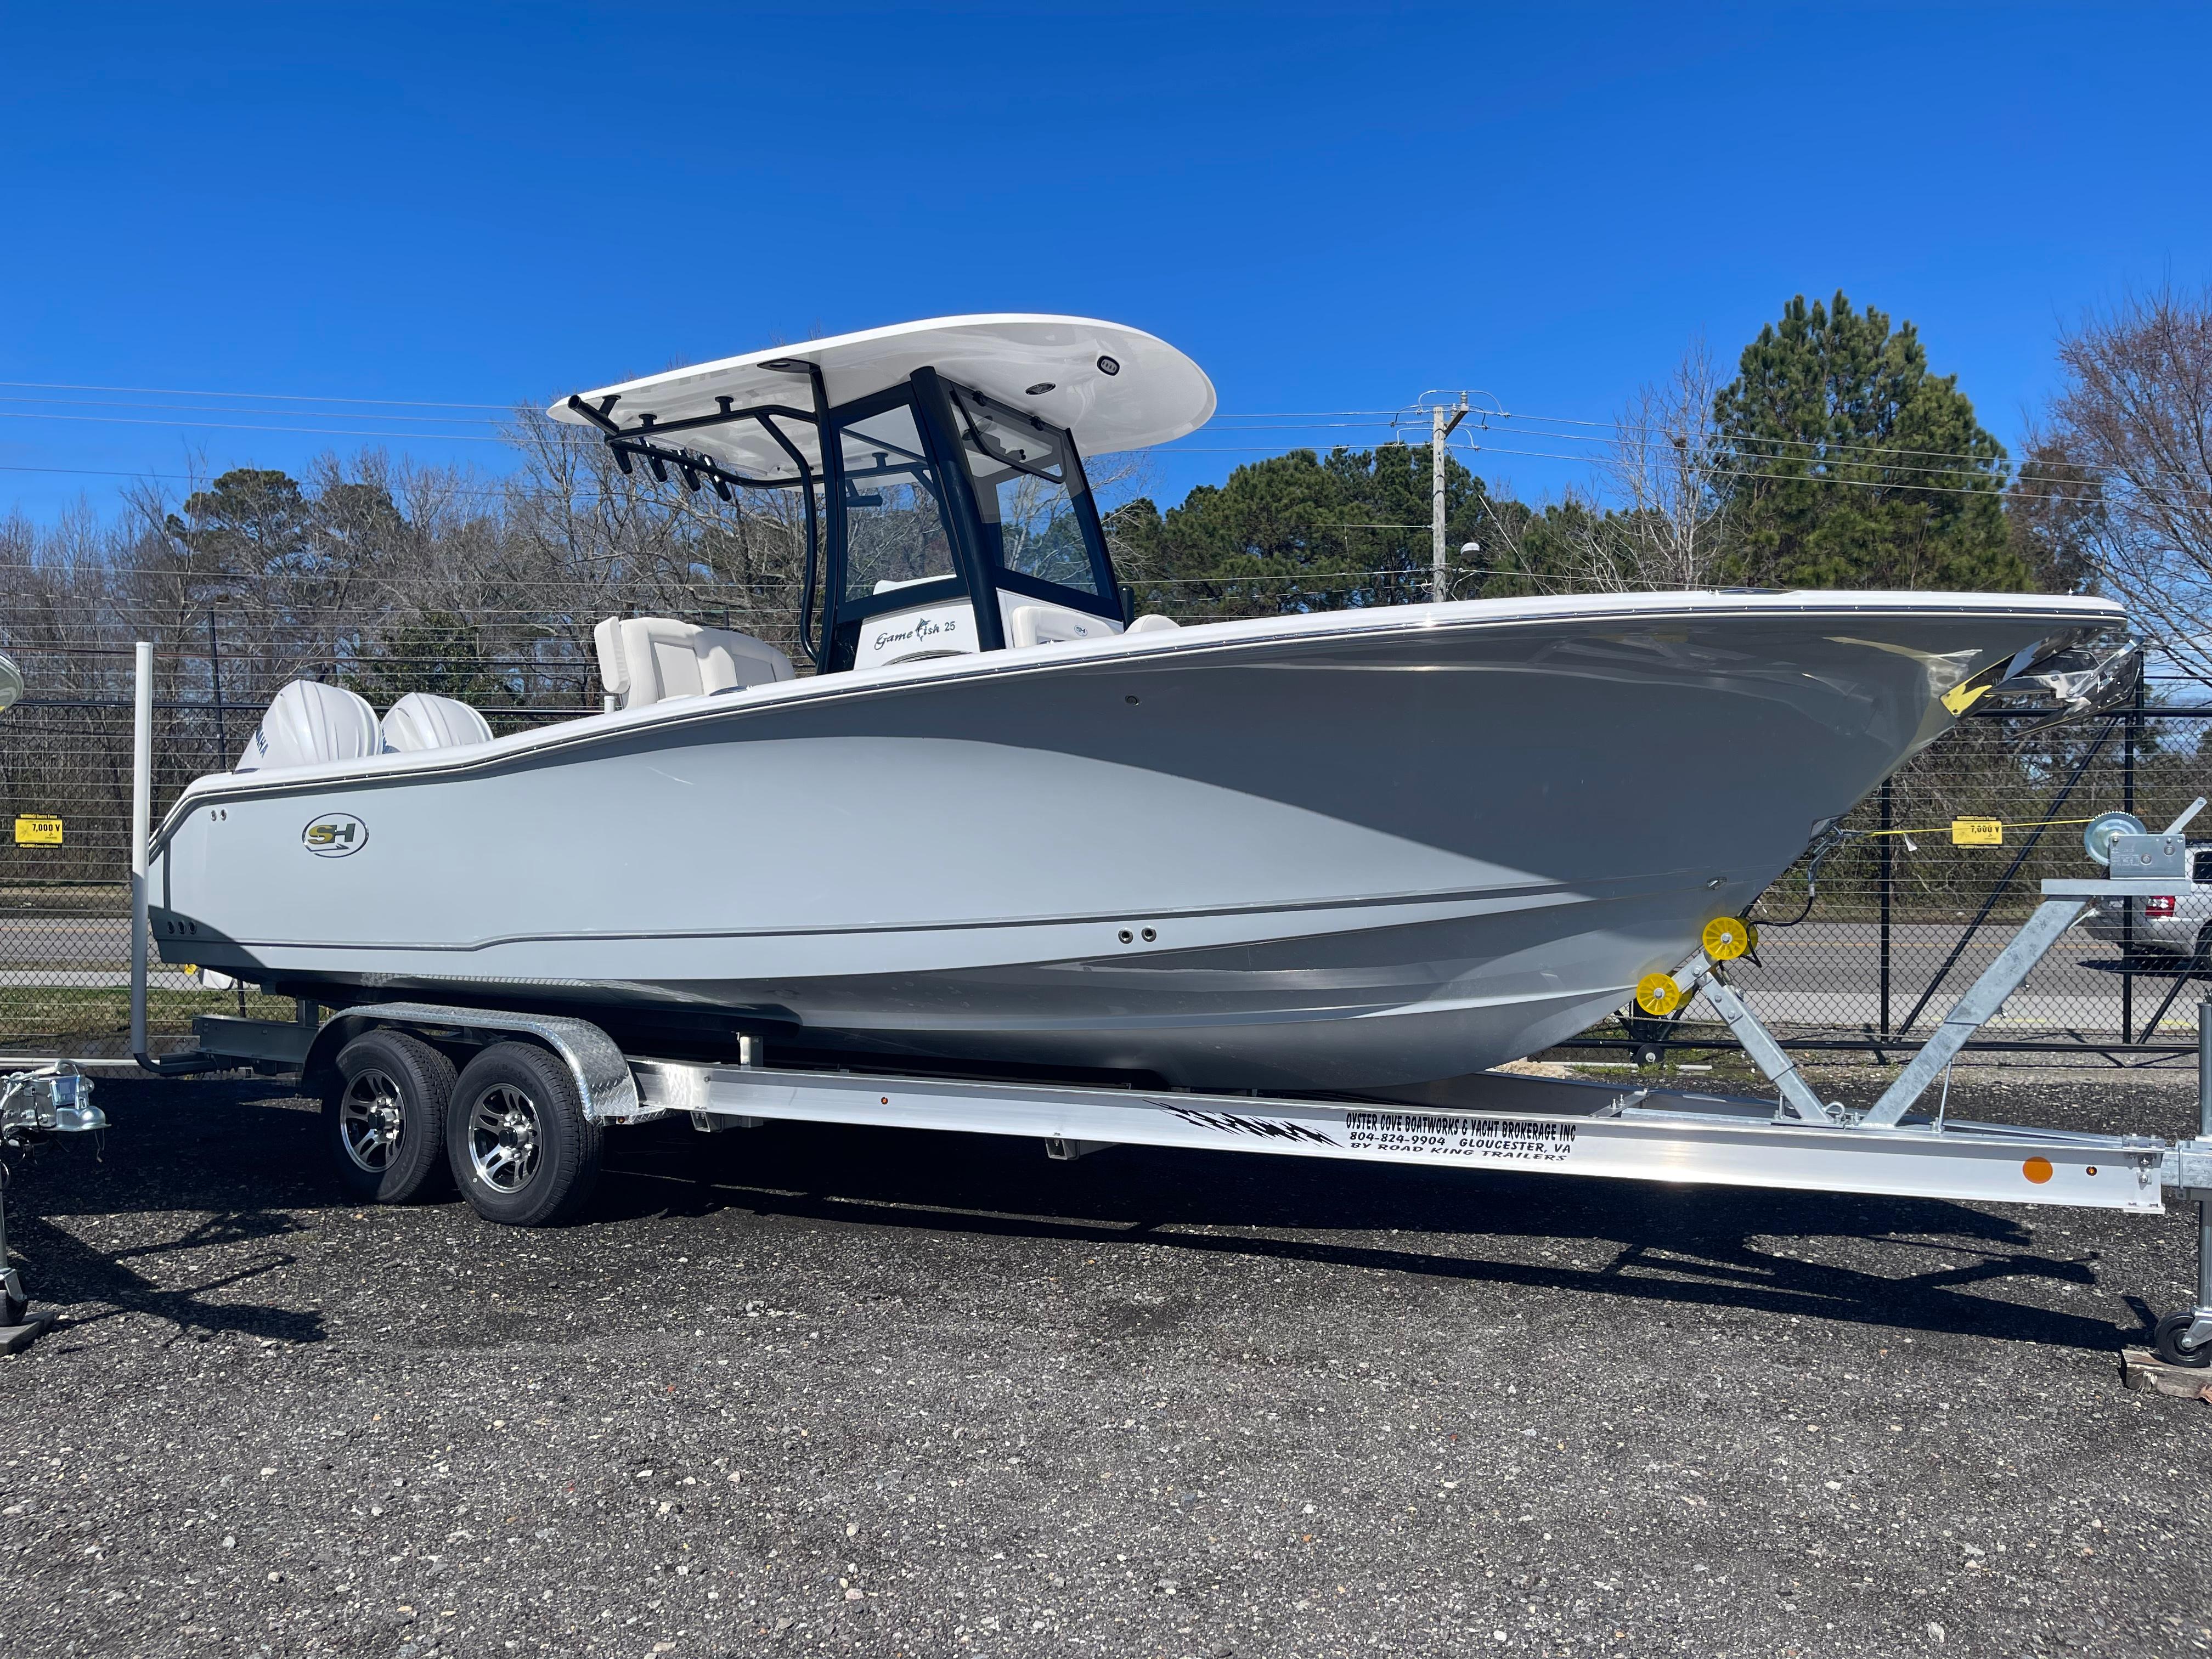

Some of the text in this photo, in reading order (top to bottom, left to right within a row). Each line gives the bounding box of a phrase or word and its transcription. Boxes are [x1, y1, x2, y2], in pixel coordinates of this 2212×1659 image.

[874, 630, 913, 651] Game
[944, 620, 956, 632] 25
[32, 823, 53, 832] 7,000
[307, 823, 356, 844] SH
[1971, 825, 1992, 833] 7,000
[1346, 1112, 1576, 1142] OYSTER COVE BOATWORKS & YACHT BROKERAGE INC
[1349, 1131, 1571, 1154] 804-824-9904 GLOUCESTER, VA
[1378, 1144, 1424, 1152] ROAD
[1481, 1150, 1567, 1161] TRAILERS
